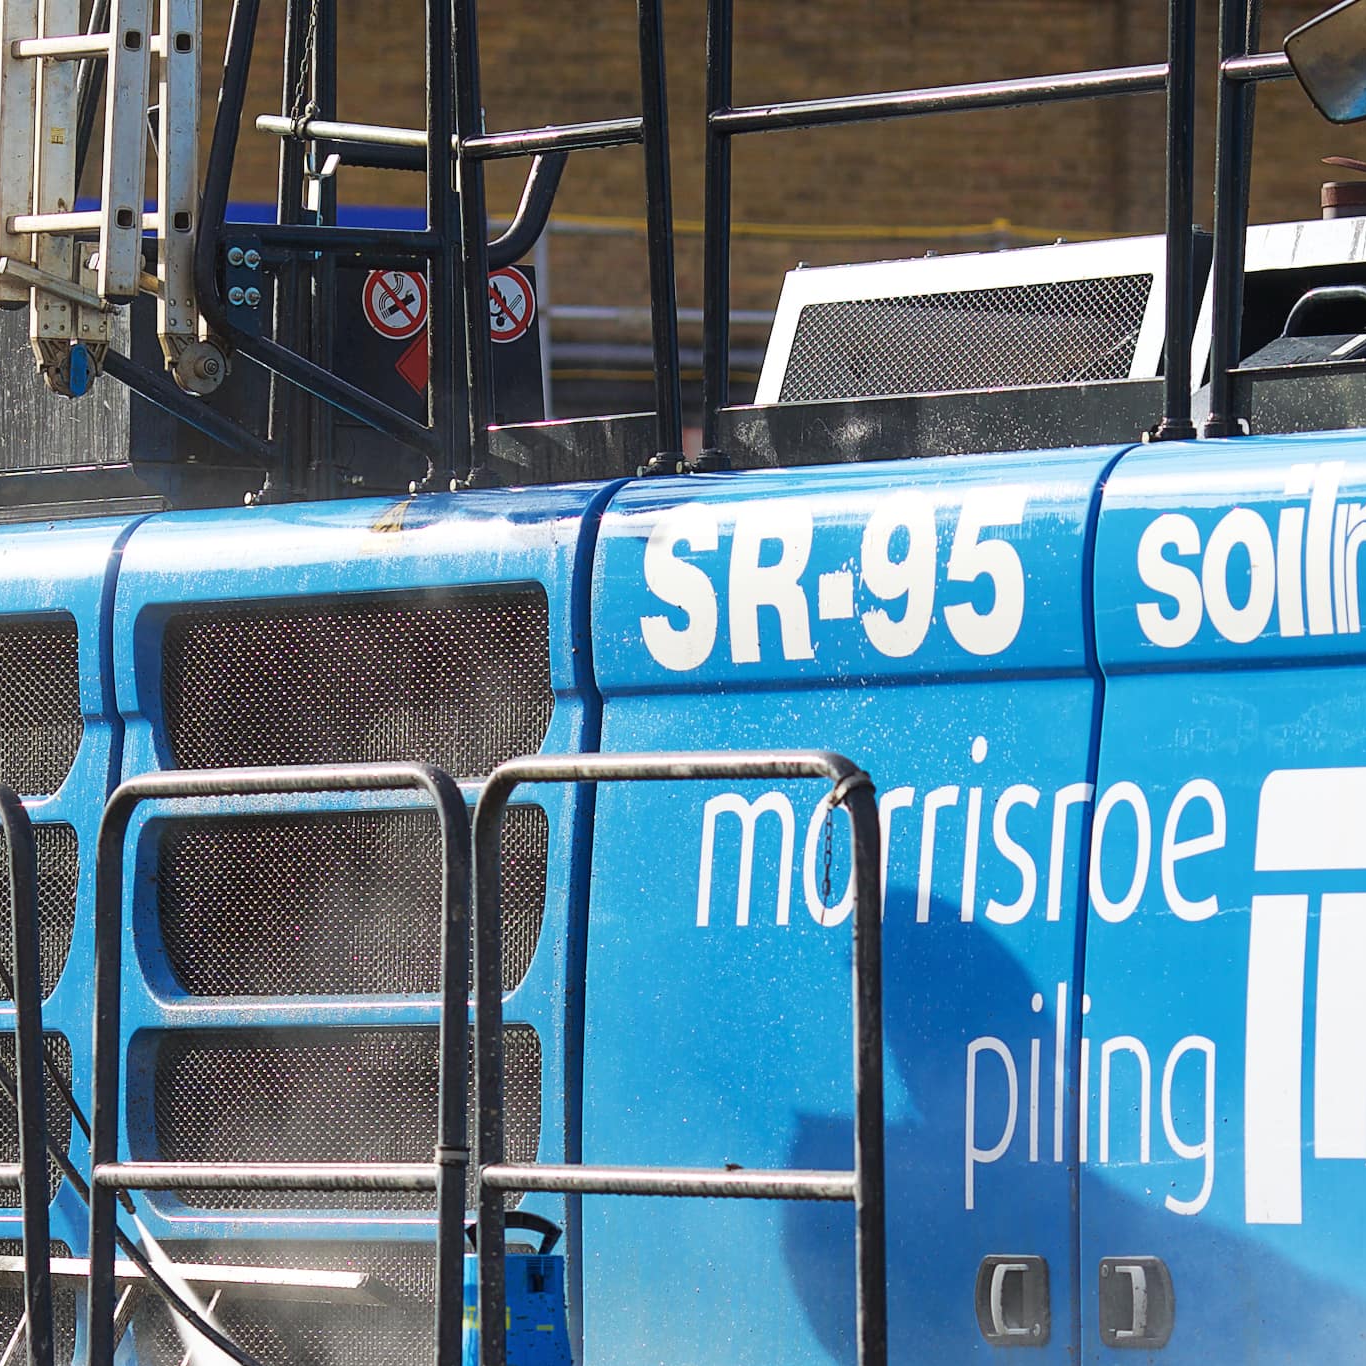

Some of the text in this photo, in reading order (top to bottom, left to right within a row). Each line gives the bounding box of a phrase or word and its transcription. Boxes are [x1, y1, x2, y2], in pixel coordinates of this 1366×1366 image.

[639, 484, 1030, 672] SR-95
[695, 735, 1227, 928] morrisroe
[964, 981, 1216, 1216] piling
